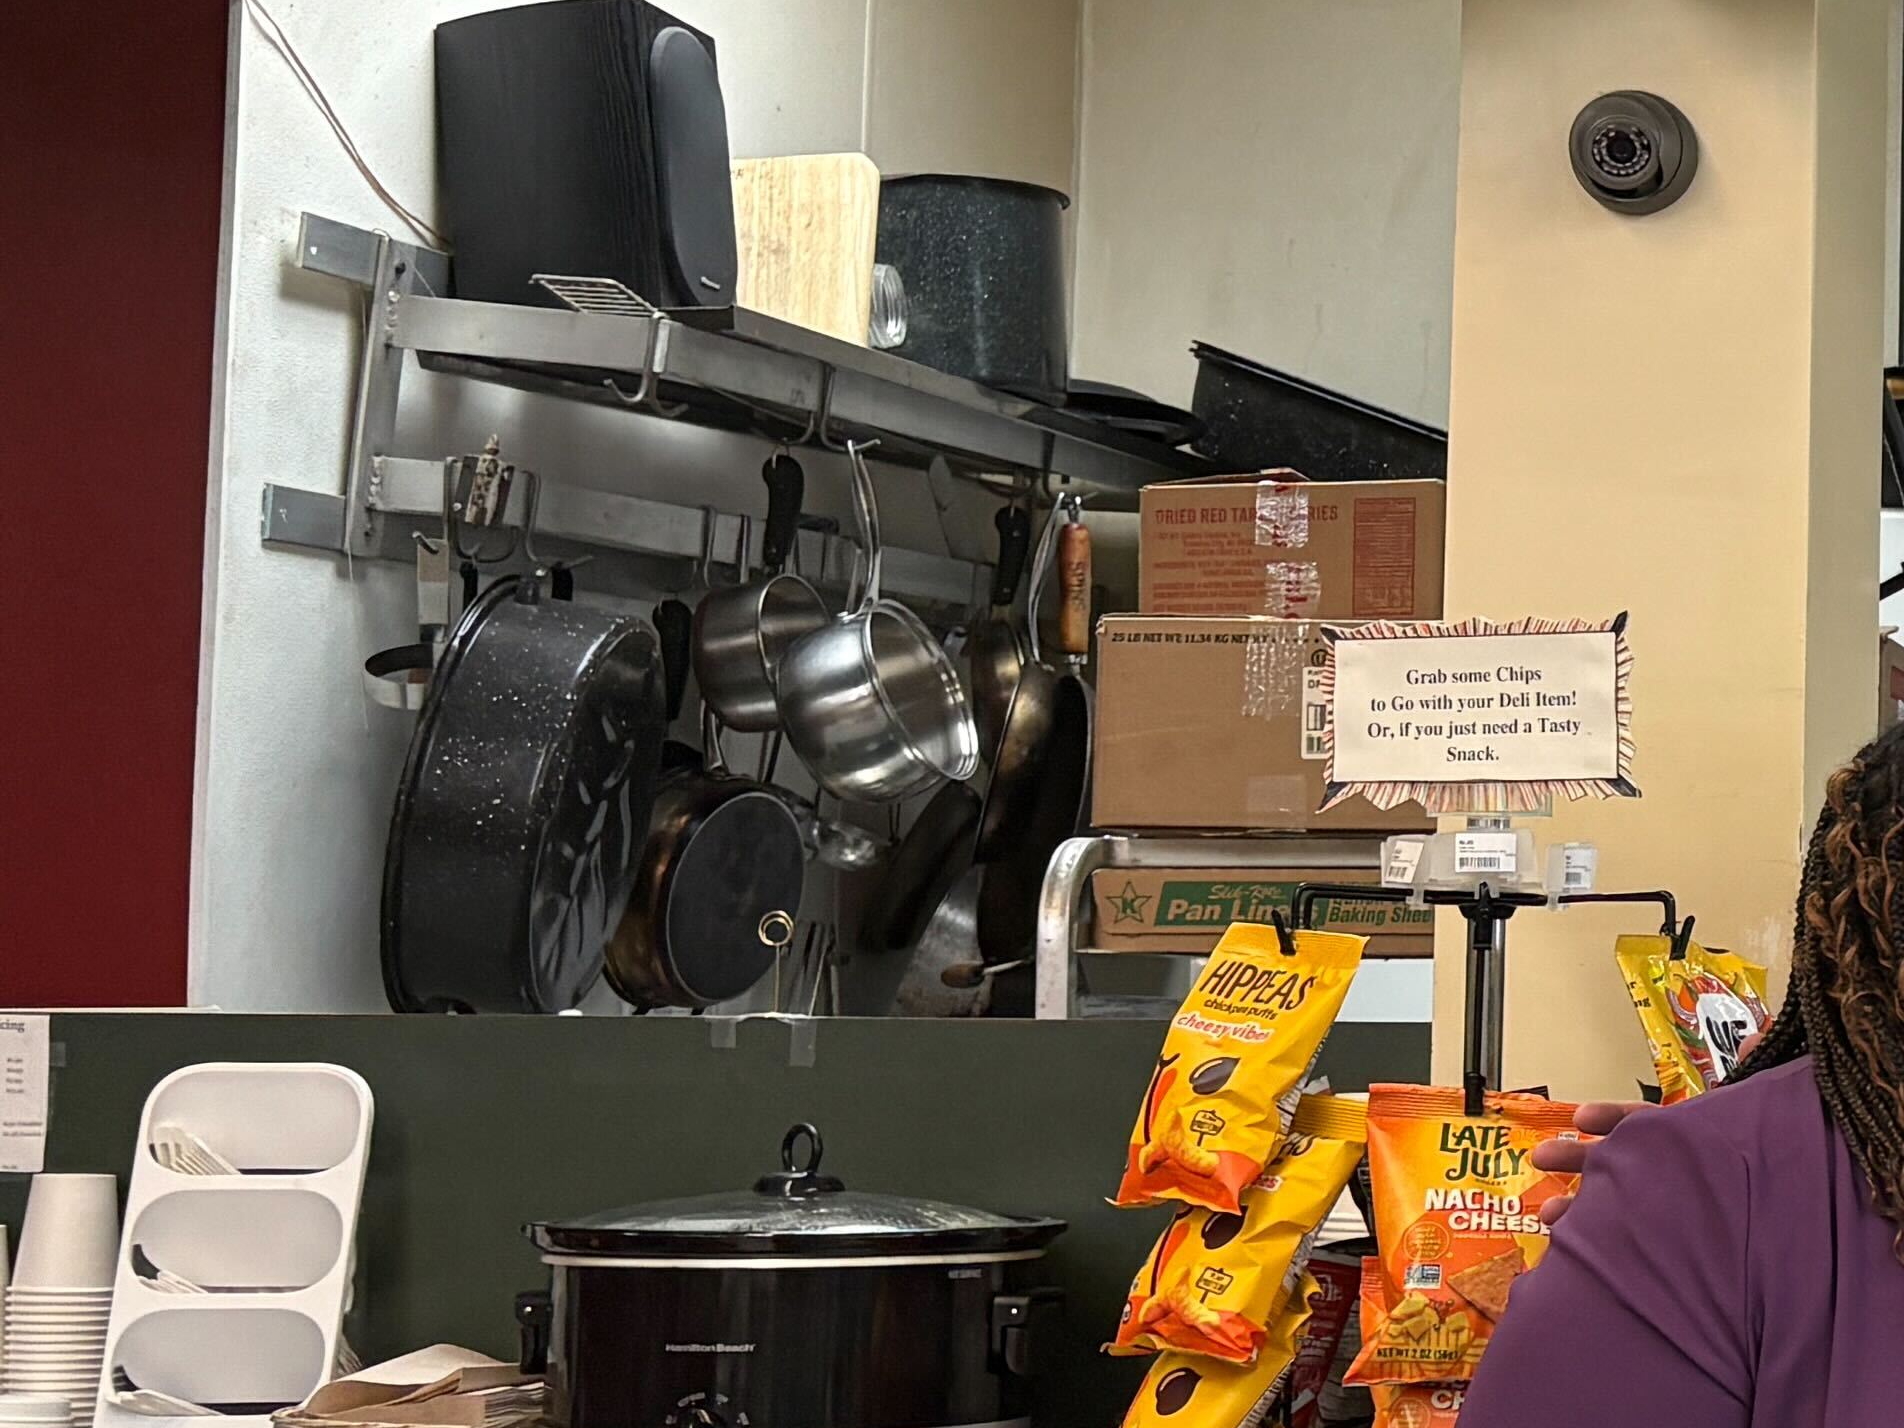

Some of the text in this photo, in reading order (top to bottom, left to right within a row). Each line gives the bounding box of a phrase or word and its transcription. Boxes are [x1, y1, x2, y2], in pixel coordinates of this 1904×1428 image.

[1155, 508, 1228, 524] DRIED RED
[1406, 666, 1542, 685] Grab some Chips
[1371, 691, 1577, 712] to Go with your Deli Item!
[1367, 717, 1581, 740] Or, if you just need a Tasty
[1446, 745, 1499, 762] Snack.
[1199, 960, 1318, 1011] HIPPEAS
[1439, 1122, 1510, 1153] LATE
[1445, 1147, 1528, 1181] JULY
[1424, 1188, 1522, 1215] NACHO
